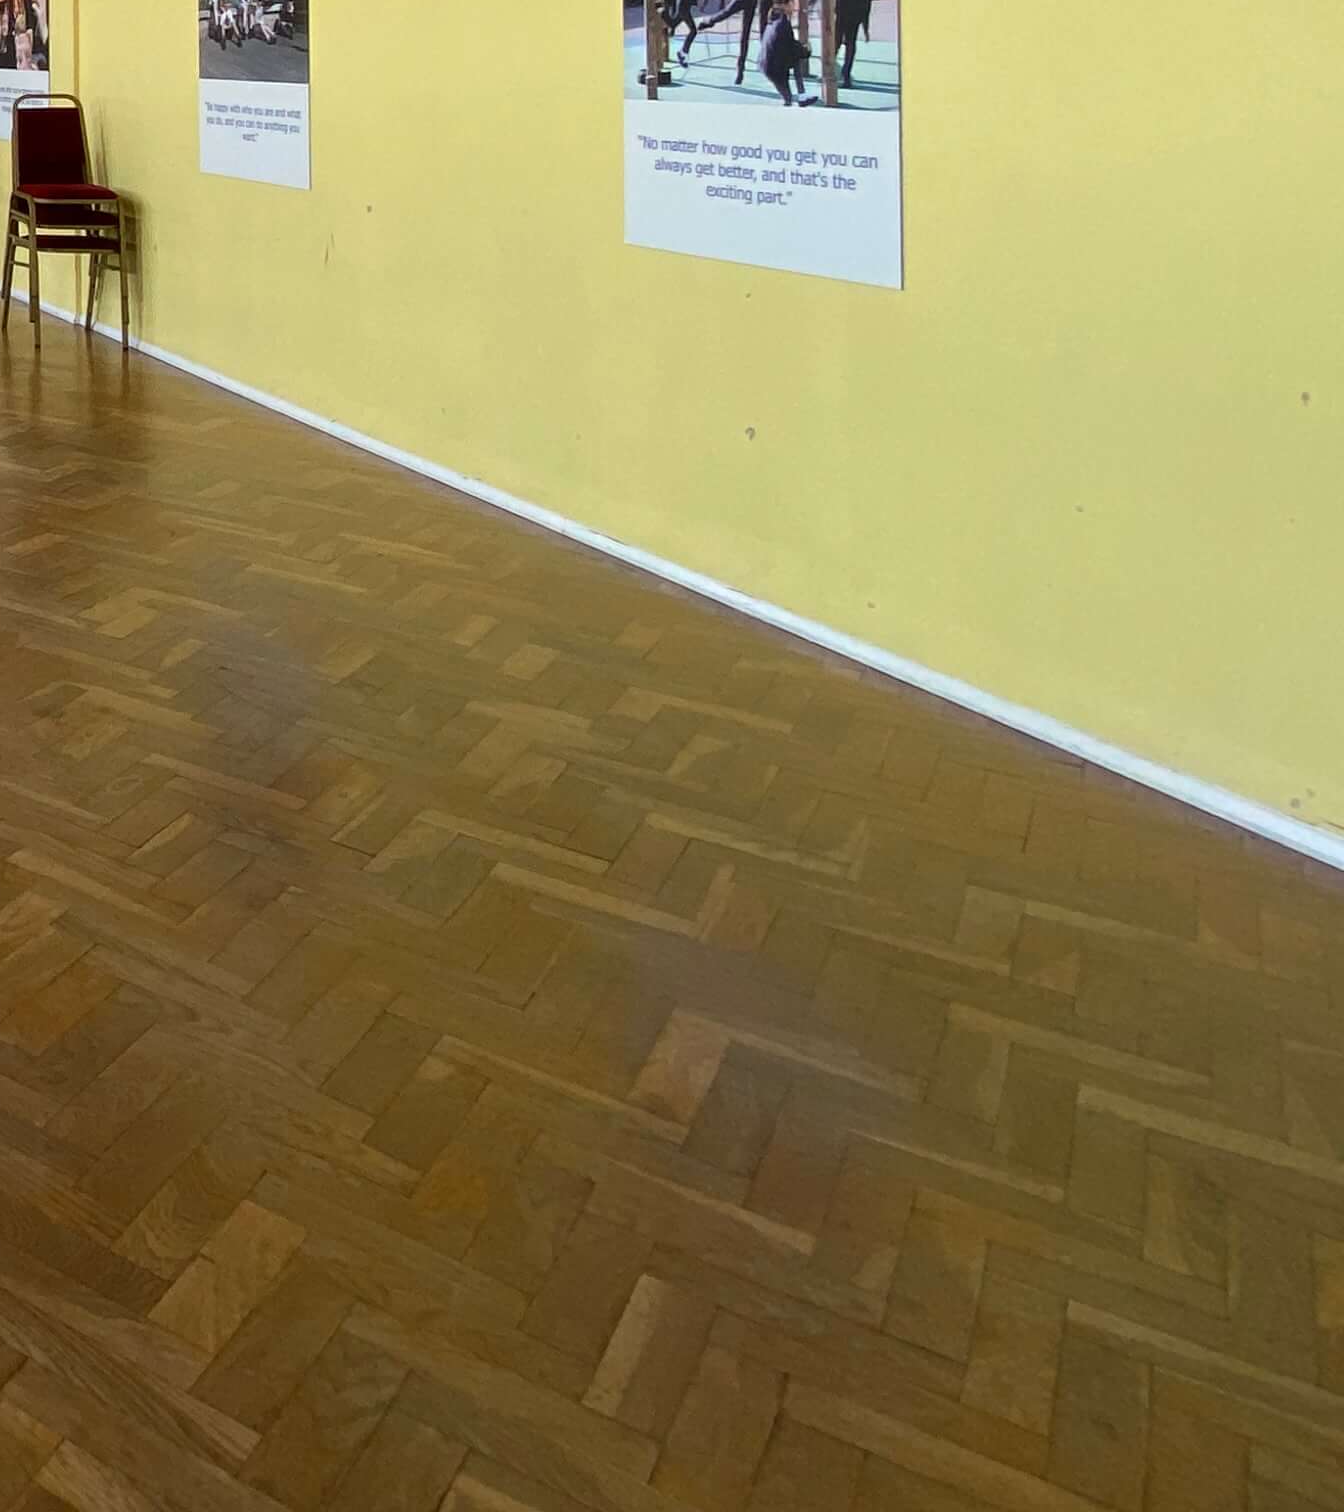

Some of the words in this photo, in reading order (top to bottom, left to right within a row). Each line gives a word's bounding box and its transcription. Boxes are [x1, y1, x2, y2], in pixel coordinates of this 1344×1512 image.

[661, 140, 699, 153] matter
[702, 140, 728, 155] how
[731, 144, 762, 160] good
[766, 148, 791, 163] you
[795, 149, 817, 166] get
[821, 152, 847, 168] you
[852, 155, 878, 169] can
[654, 157, 692, 176] always
[695, 163, 714, 178] get
[718, 164, 757, 183] better,
[761, 168, 786, 183] and
[832, 173, 857, 190] the
[706, 185, 752, 205] exciting
